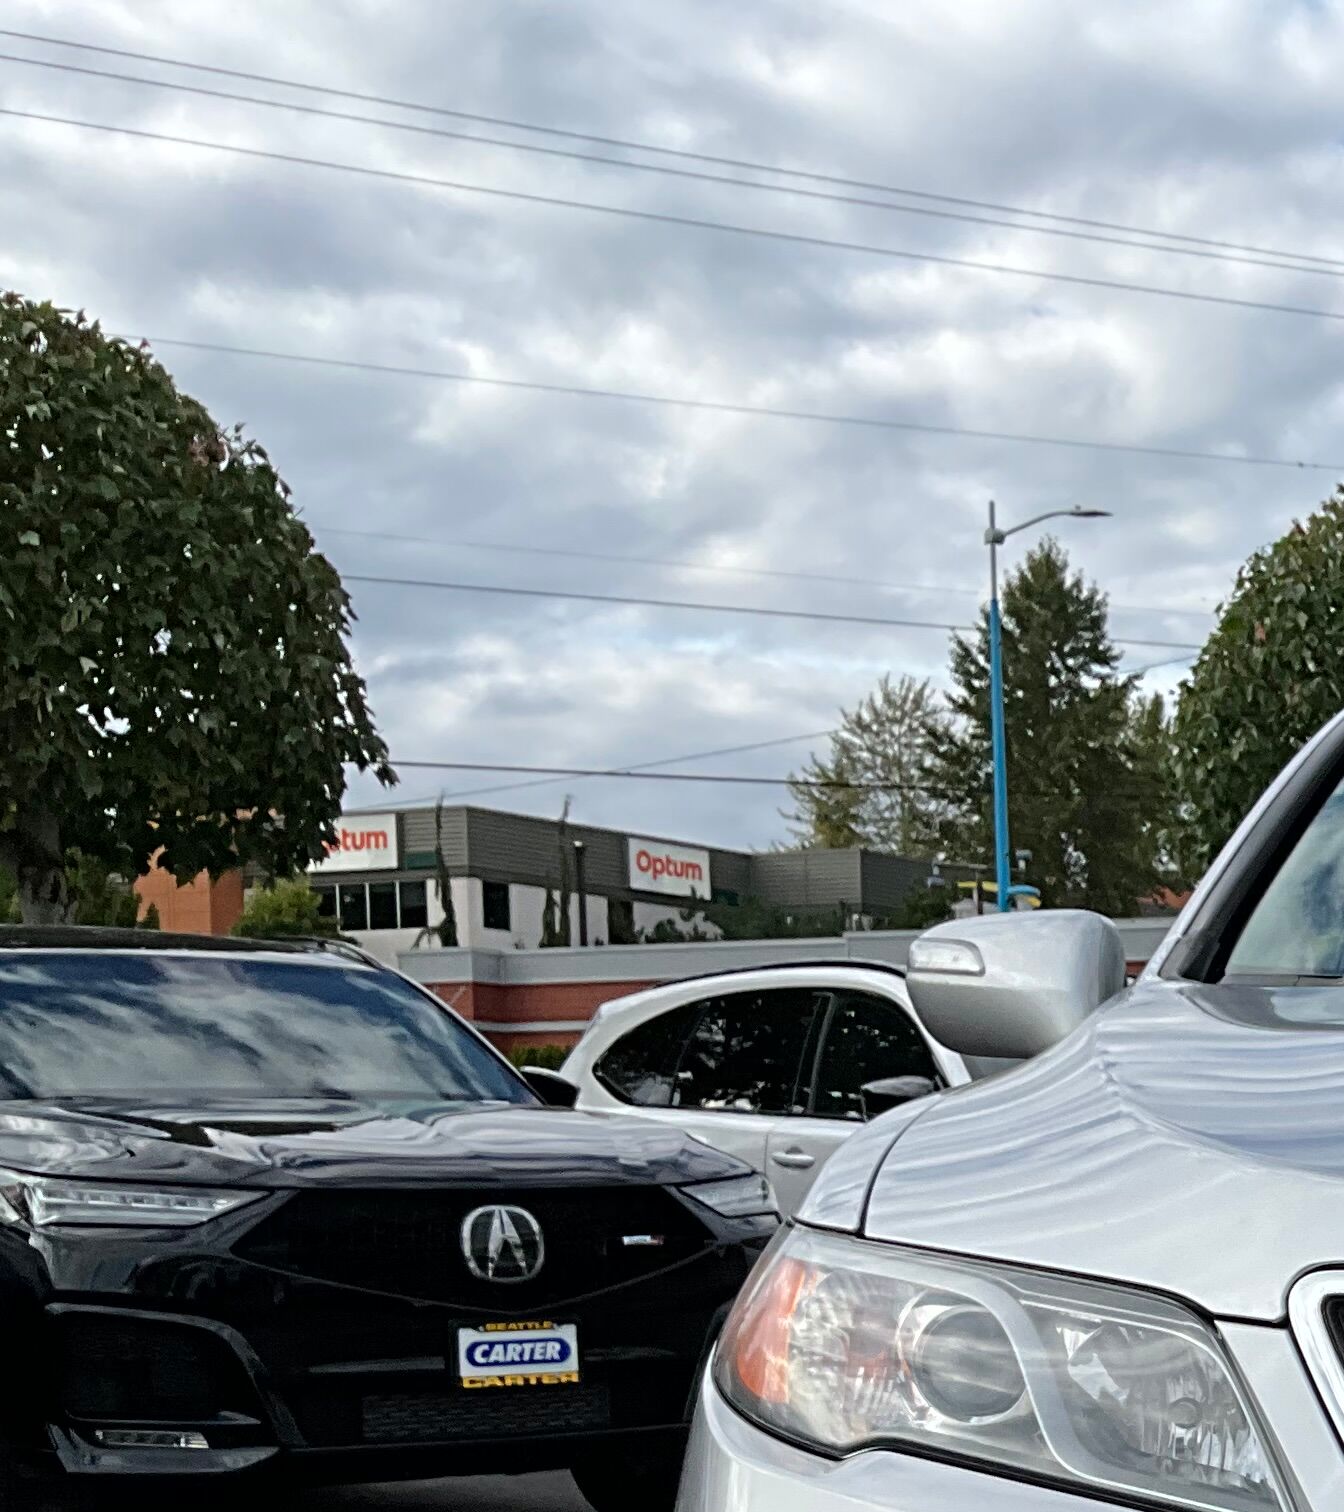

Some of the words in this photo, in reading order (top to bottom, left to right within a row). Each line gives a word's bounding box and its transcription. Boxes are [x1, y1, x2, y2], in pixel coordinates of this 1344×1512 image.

[332, 827, 389, 852] tum
[636, 850, 703, 880] Optum
[485, 1321, 553, 1331] SEATTLE
[473, 1340, 561, 1364] CARTER
[463, 1373, 579, 1388] CARTER
